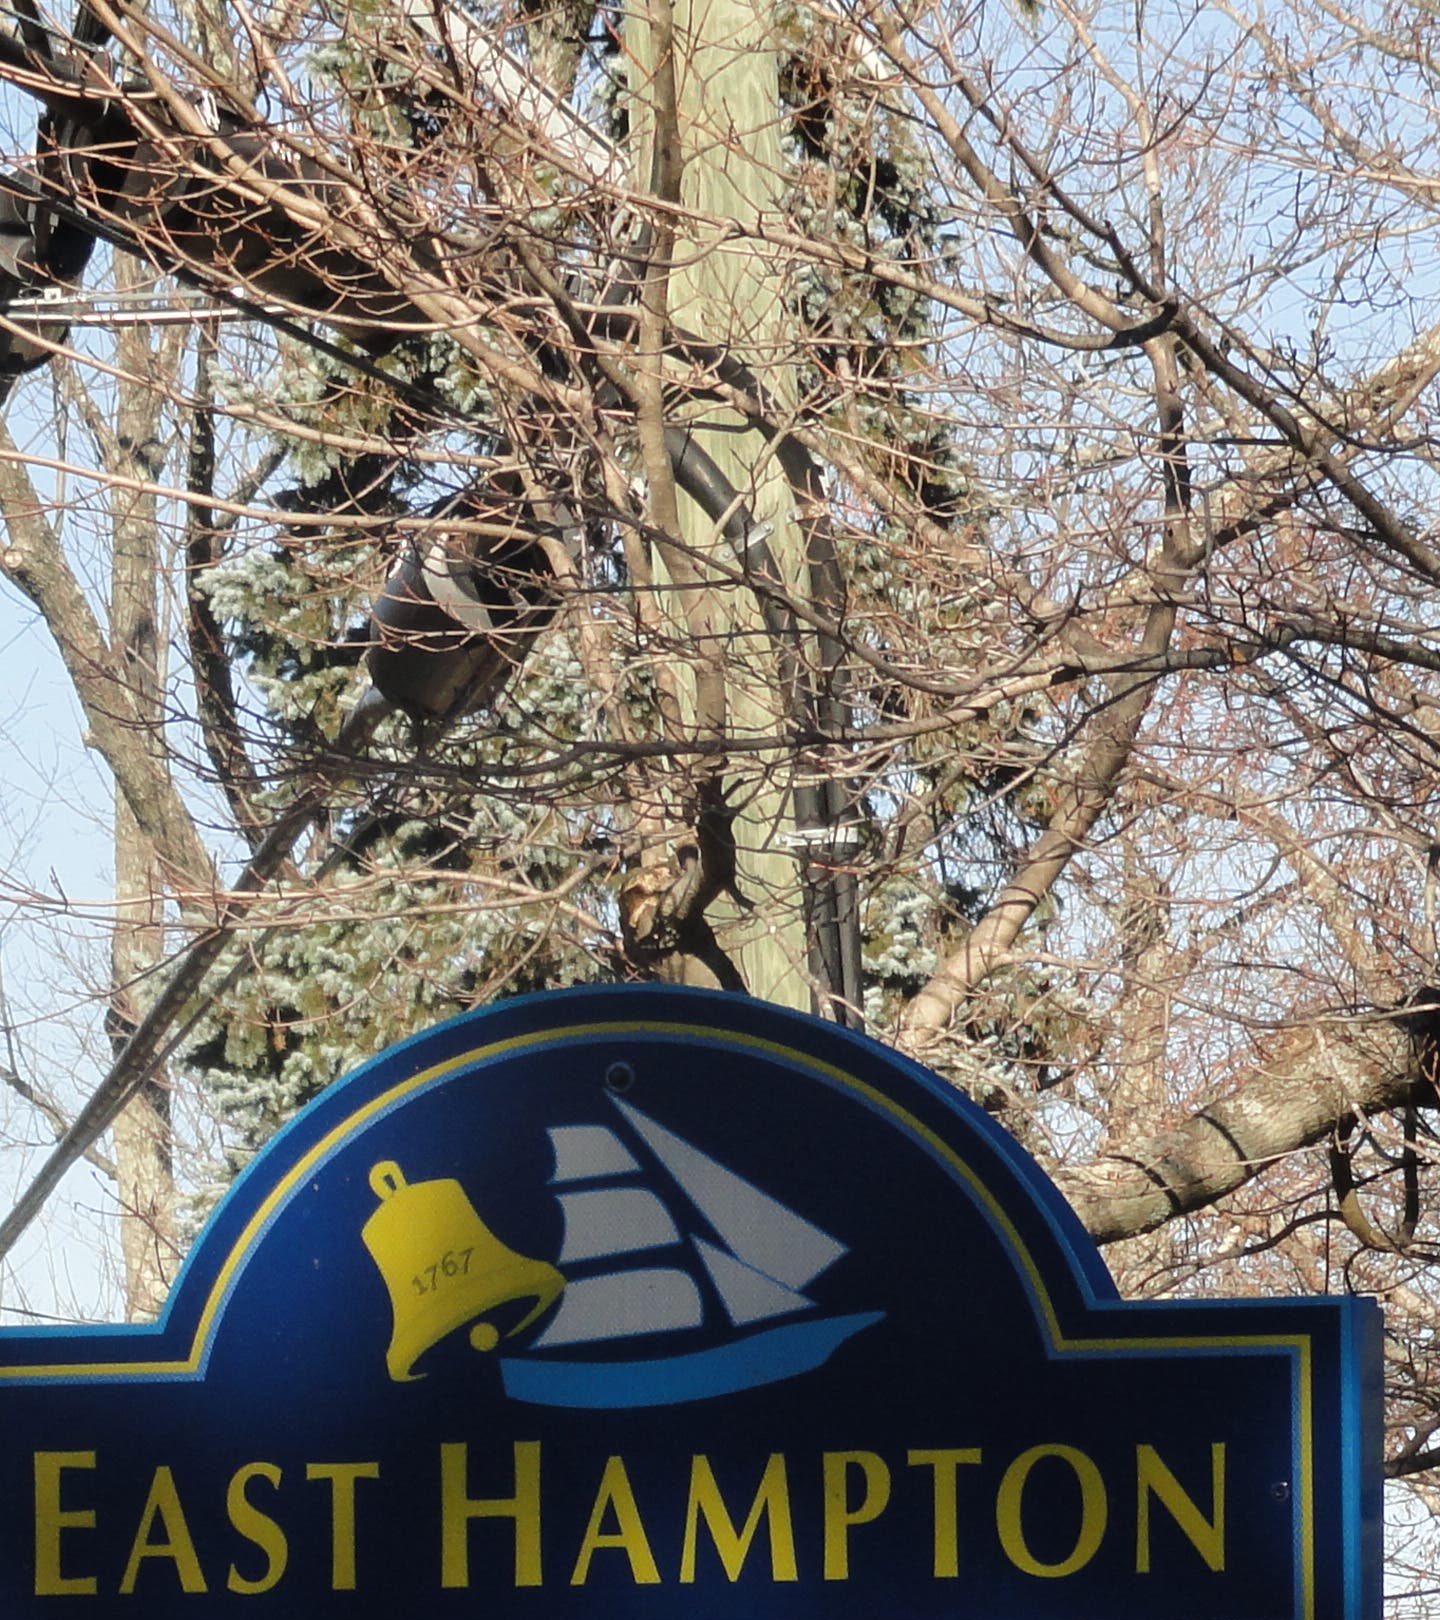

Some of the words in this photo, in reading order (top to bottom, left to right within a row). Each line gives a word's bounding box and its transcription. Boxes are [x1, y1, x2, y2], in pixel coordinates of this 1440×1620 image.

[411, 1246, 476, 1297] 1767
[31, 1449, 380, 1597] EAST
[440, 1439, 1227, 1589] HAMPTON
